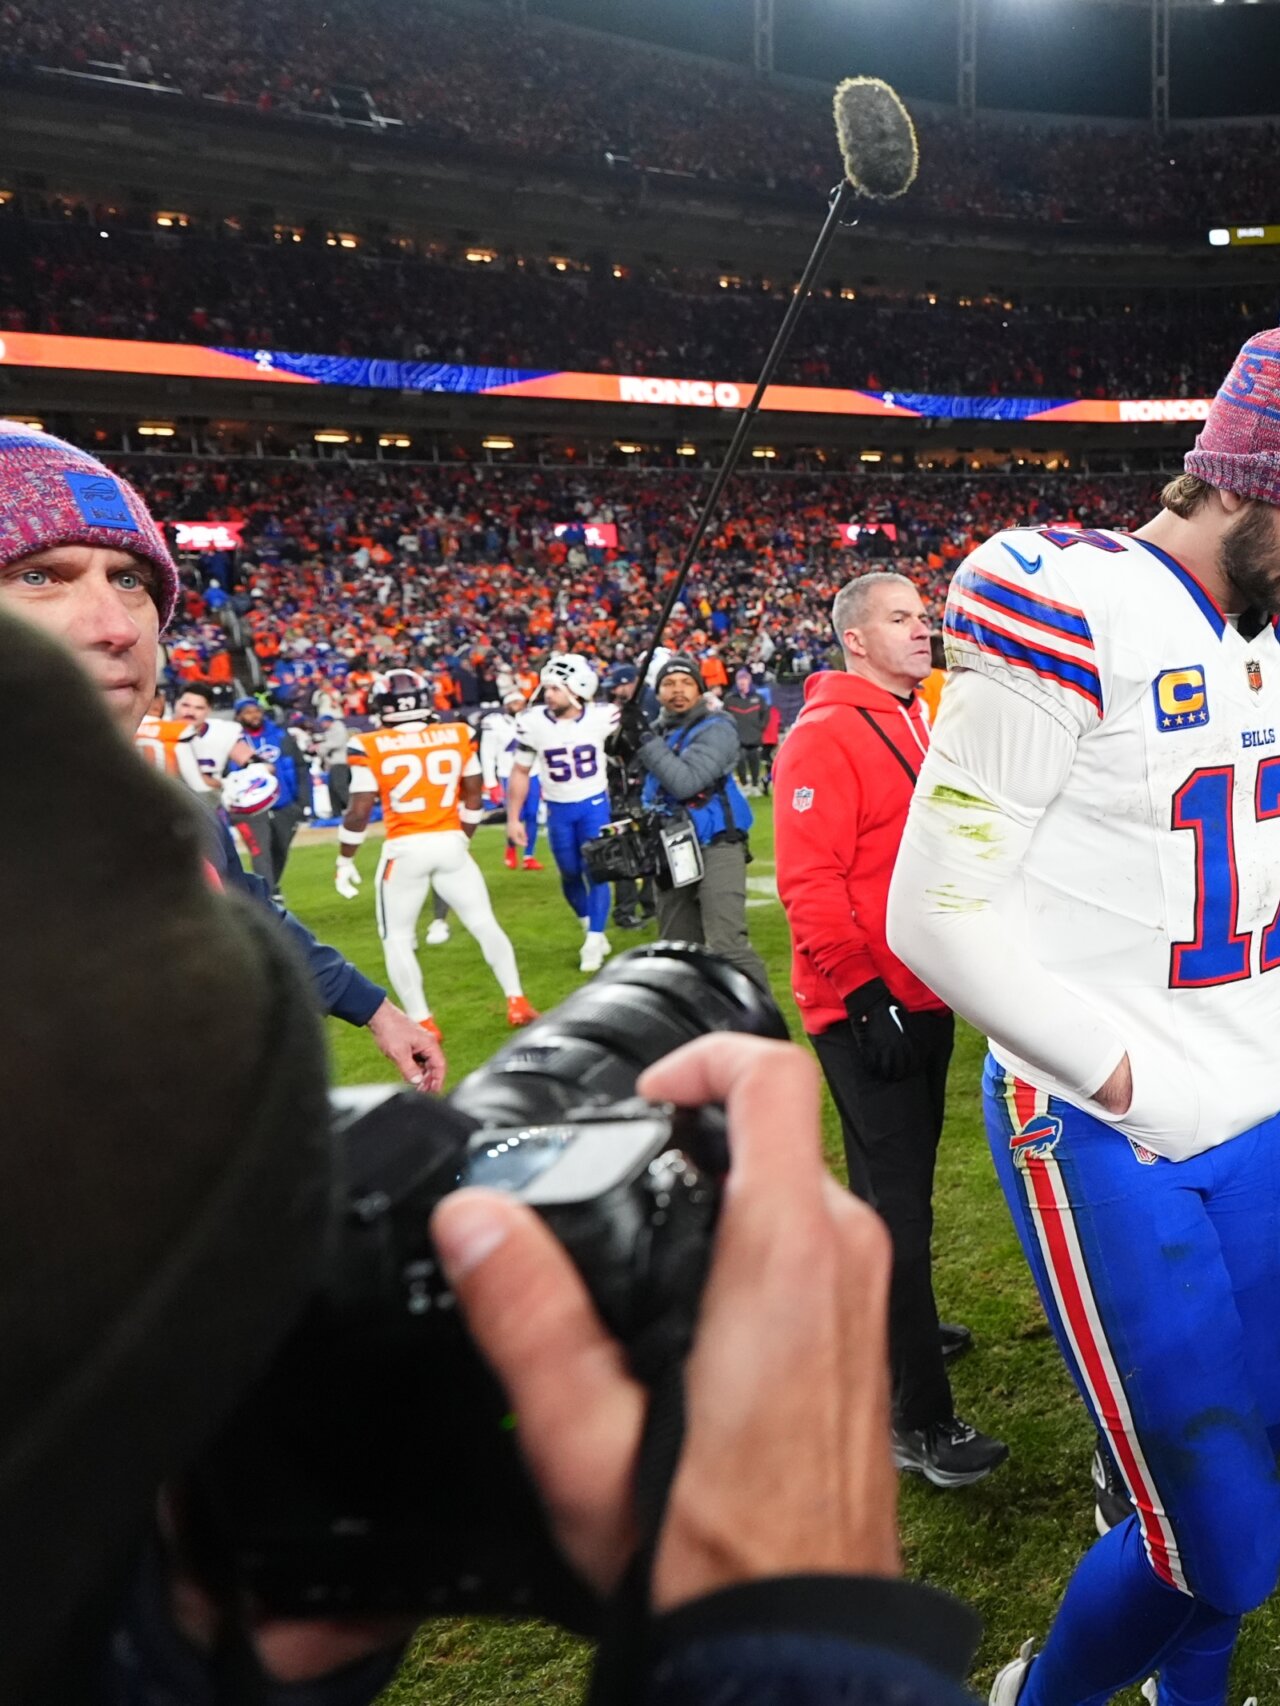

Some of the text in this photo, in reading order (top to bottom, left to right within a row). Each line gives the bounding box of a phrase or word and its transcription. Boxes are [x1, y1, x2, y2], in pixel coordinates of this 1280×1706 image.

[618, 376, 740, 407] RONCO
[1157, 669, 1205, 715] C
[1241, 728, 1276, 749] BILLS
[381, 749, 462, 813] 29
[543, 744, 598, 782] 58
